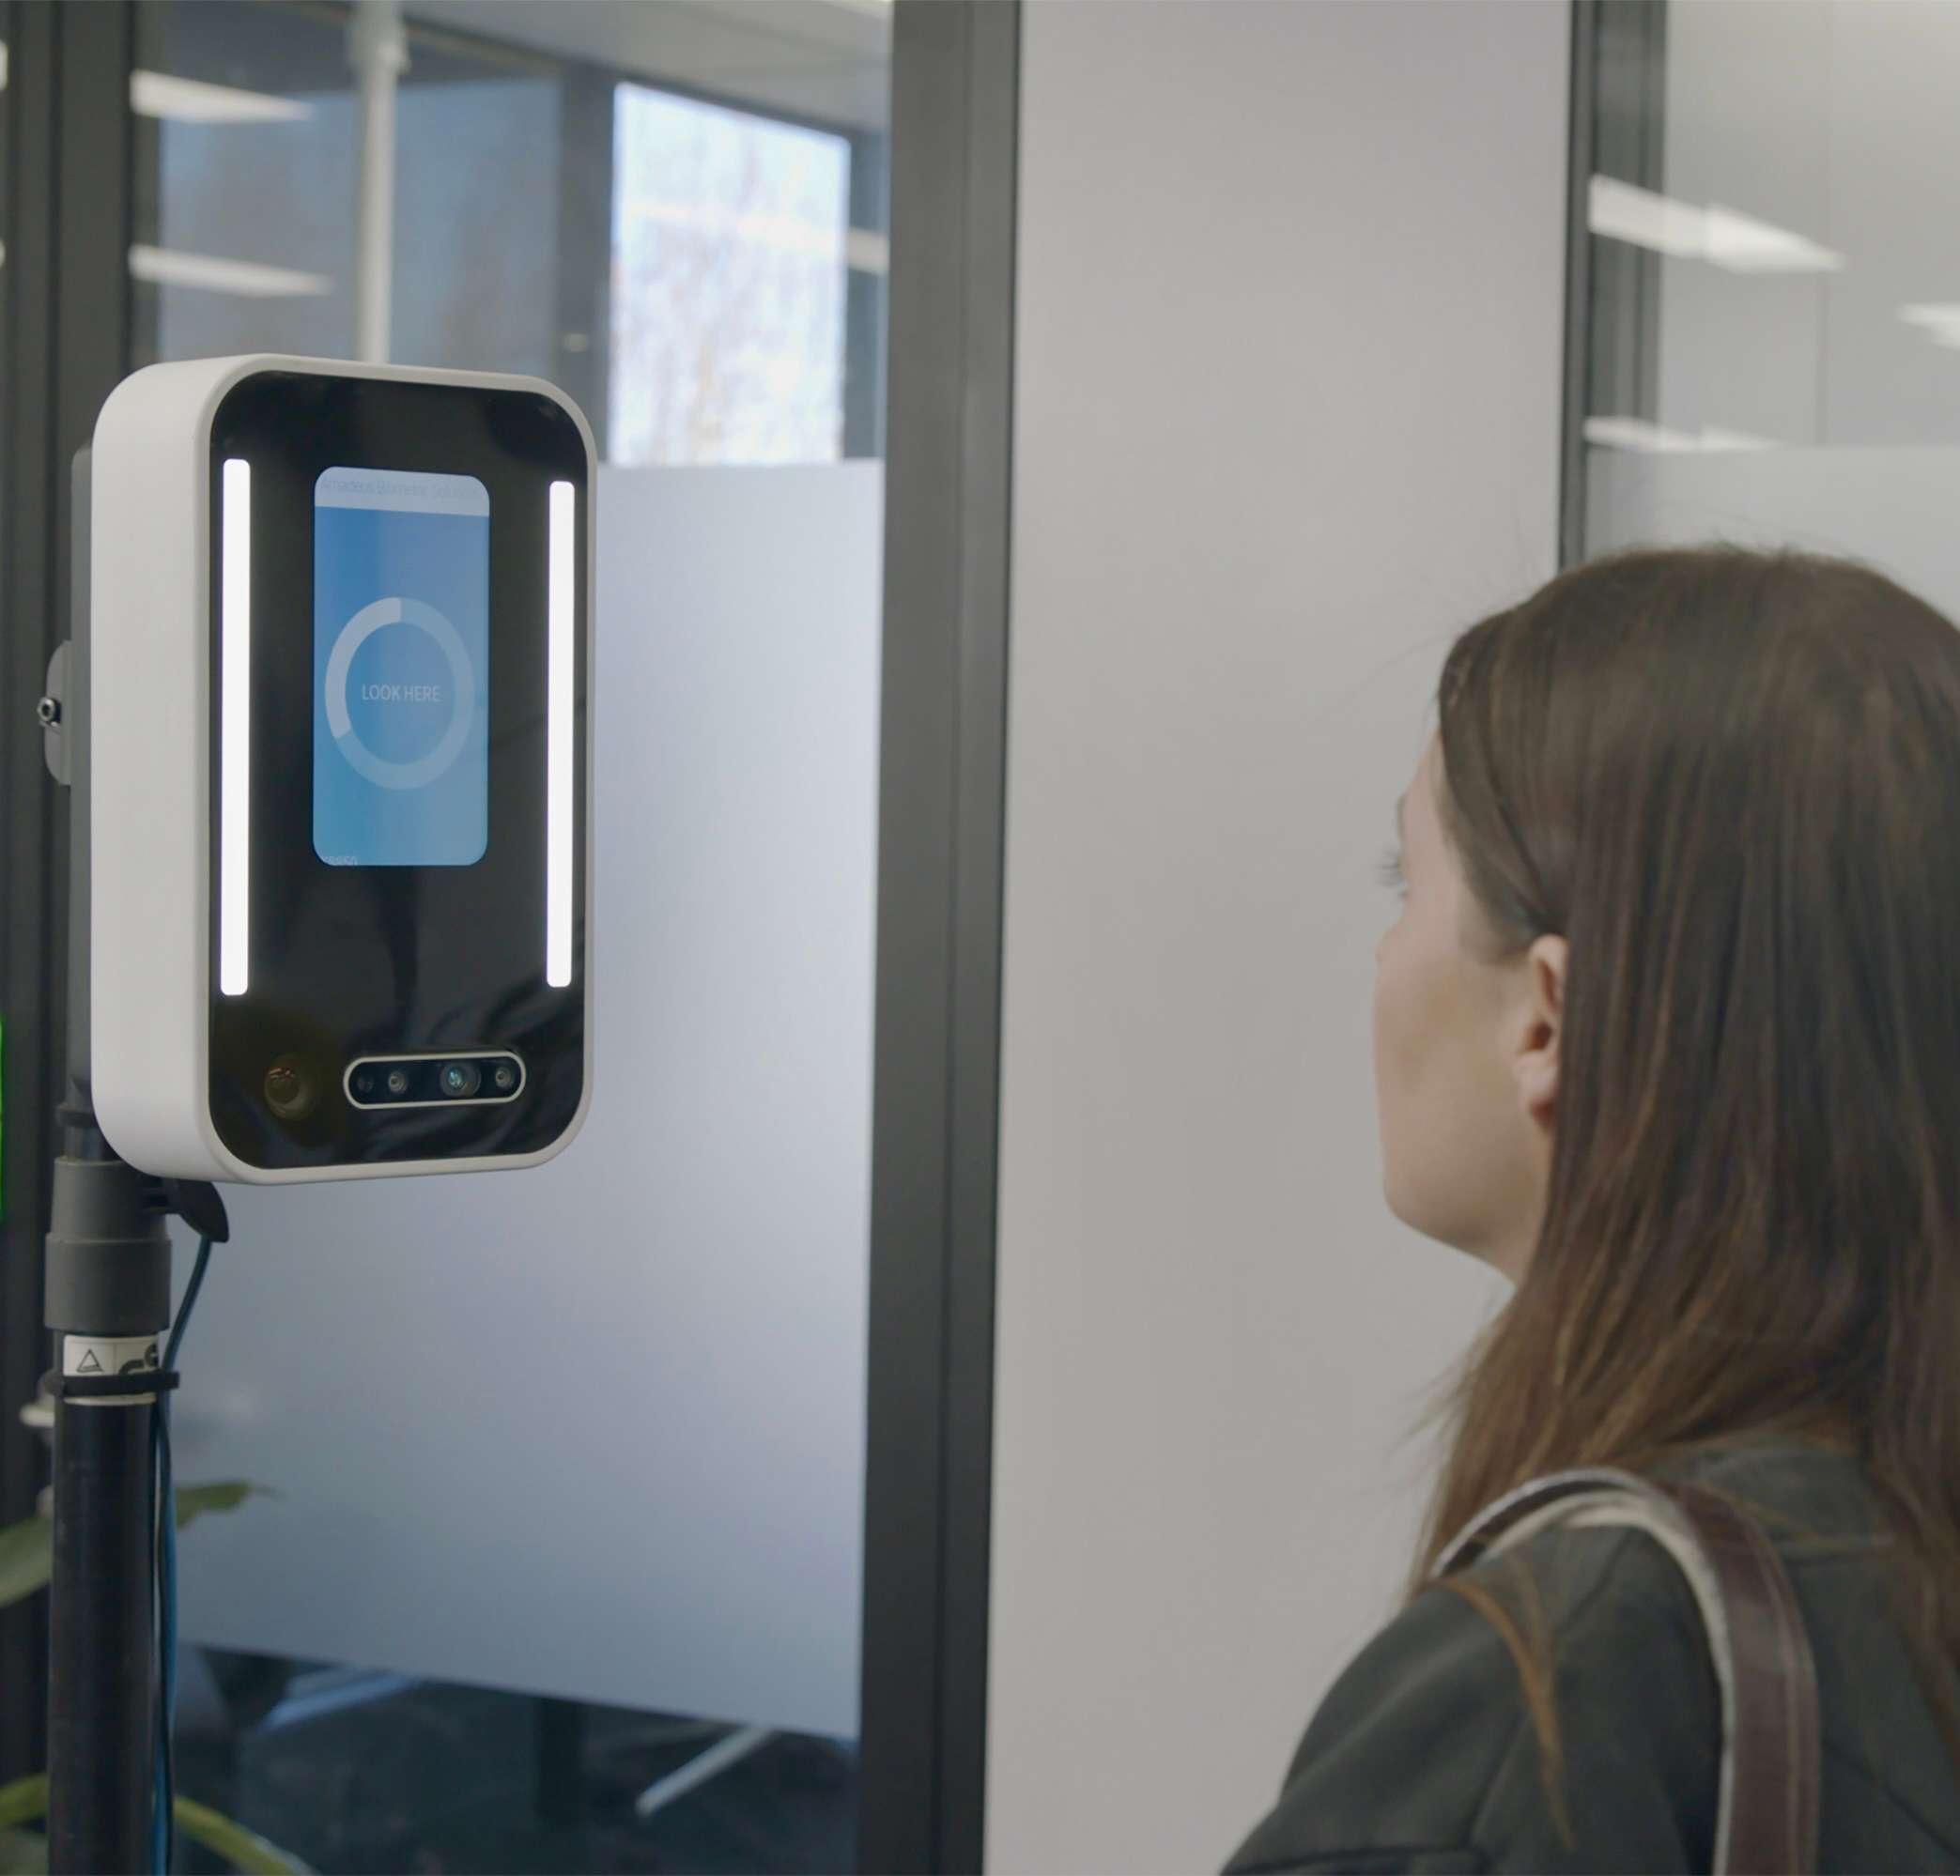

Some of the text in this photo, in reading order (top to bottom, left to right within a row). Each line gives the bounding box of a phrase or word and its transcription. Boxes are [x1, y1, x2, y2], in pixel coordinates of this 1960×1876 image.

[320, 477, 375, 495] Amadeus
[377, 480, 428, 498] Biometric
[362, 684, 440, 702] LOOK HERE
